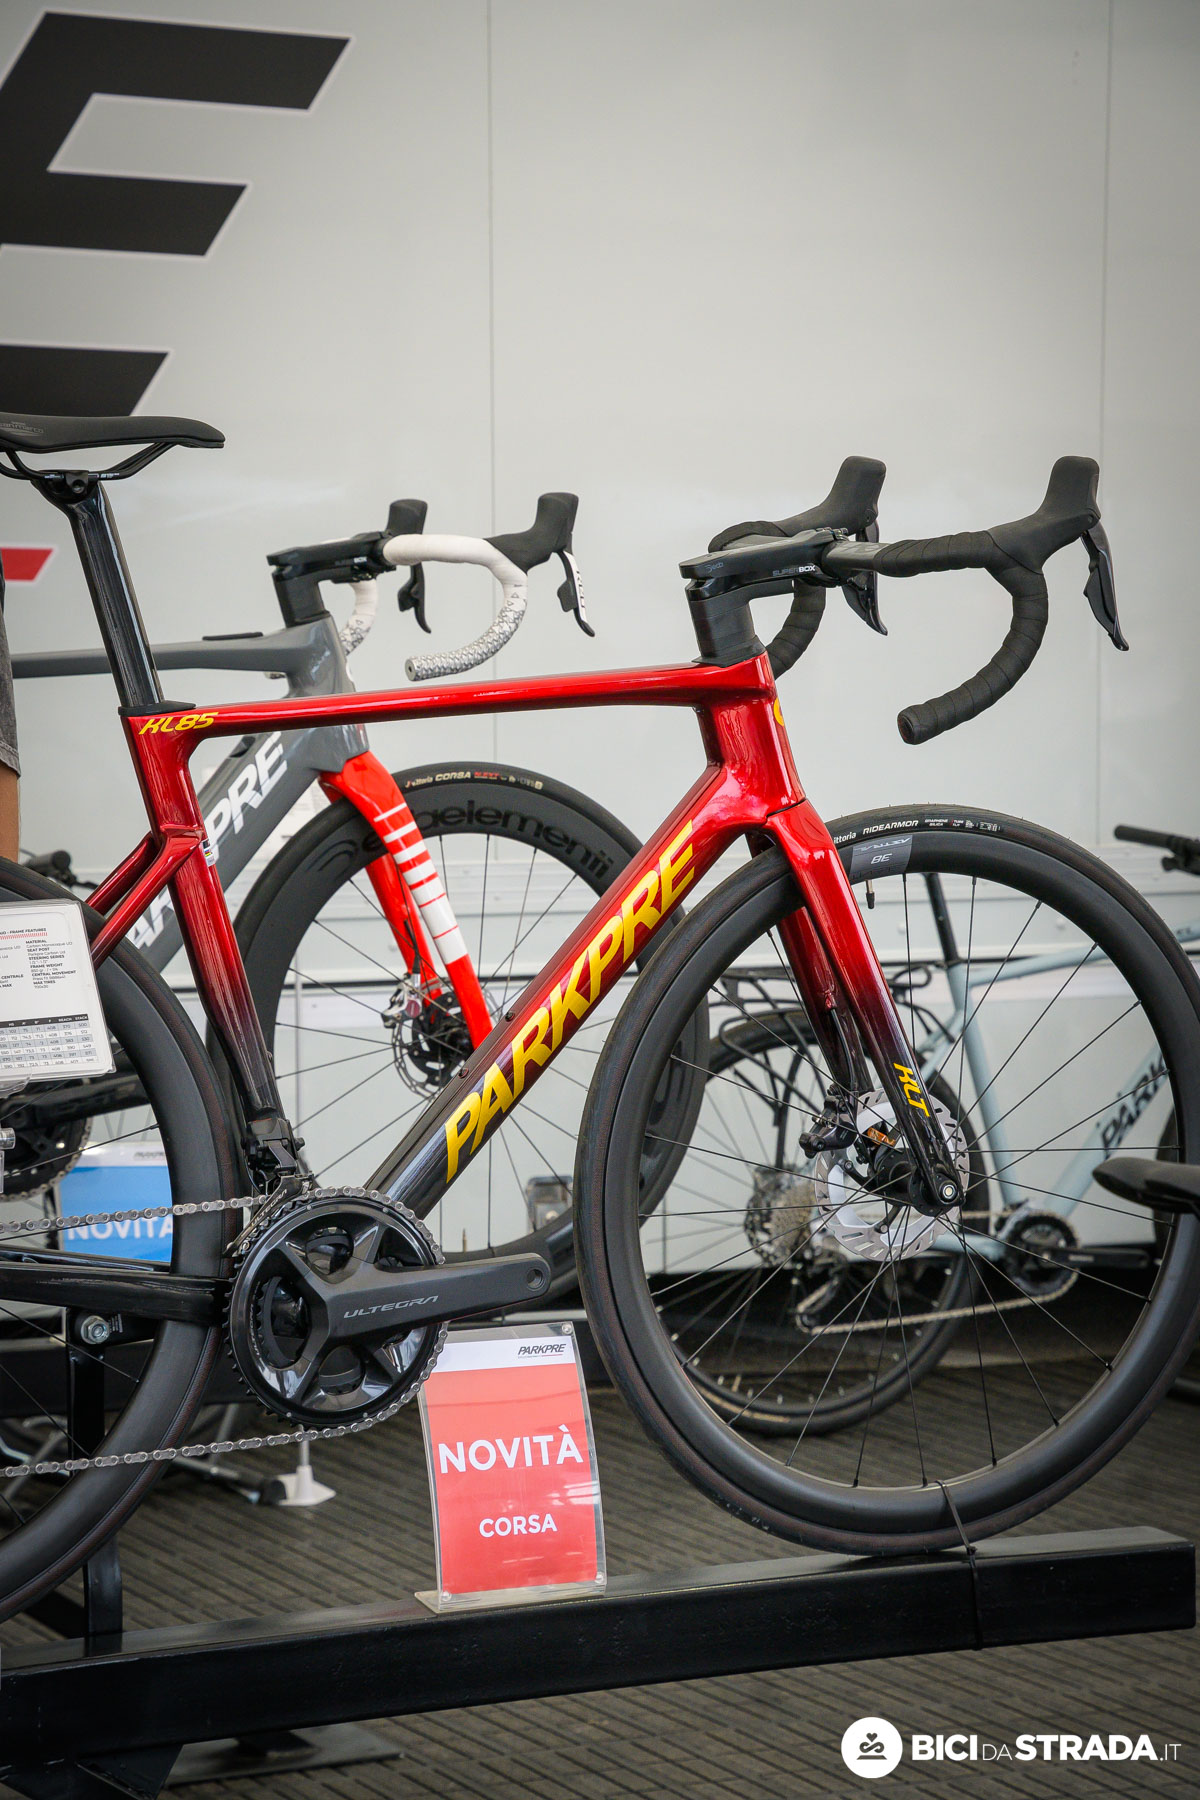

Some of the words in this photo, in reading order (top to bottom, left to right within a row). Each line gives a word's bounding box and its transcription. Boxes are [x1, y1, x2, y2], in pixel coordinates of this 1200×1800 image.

[138, 711, 219, 735] KL85
[435, 771, 471, 782] CORSA
[833, 831, 857, 845] ittoria
[862, 819, 919, 835] RIDEARMOR
[444, 819, 695, 1184] PARKPRE
[343, 1295, 439, 1318] ULTEGRA
[517, 1343, 567, 1356] PARKPRE
[438, 1424, 584, 1474] NOVITÀ
[478, 1513, 558, 1539] CORSA
